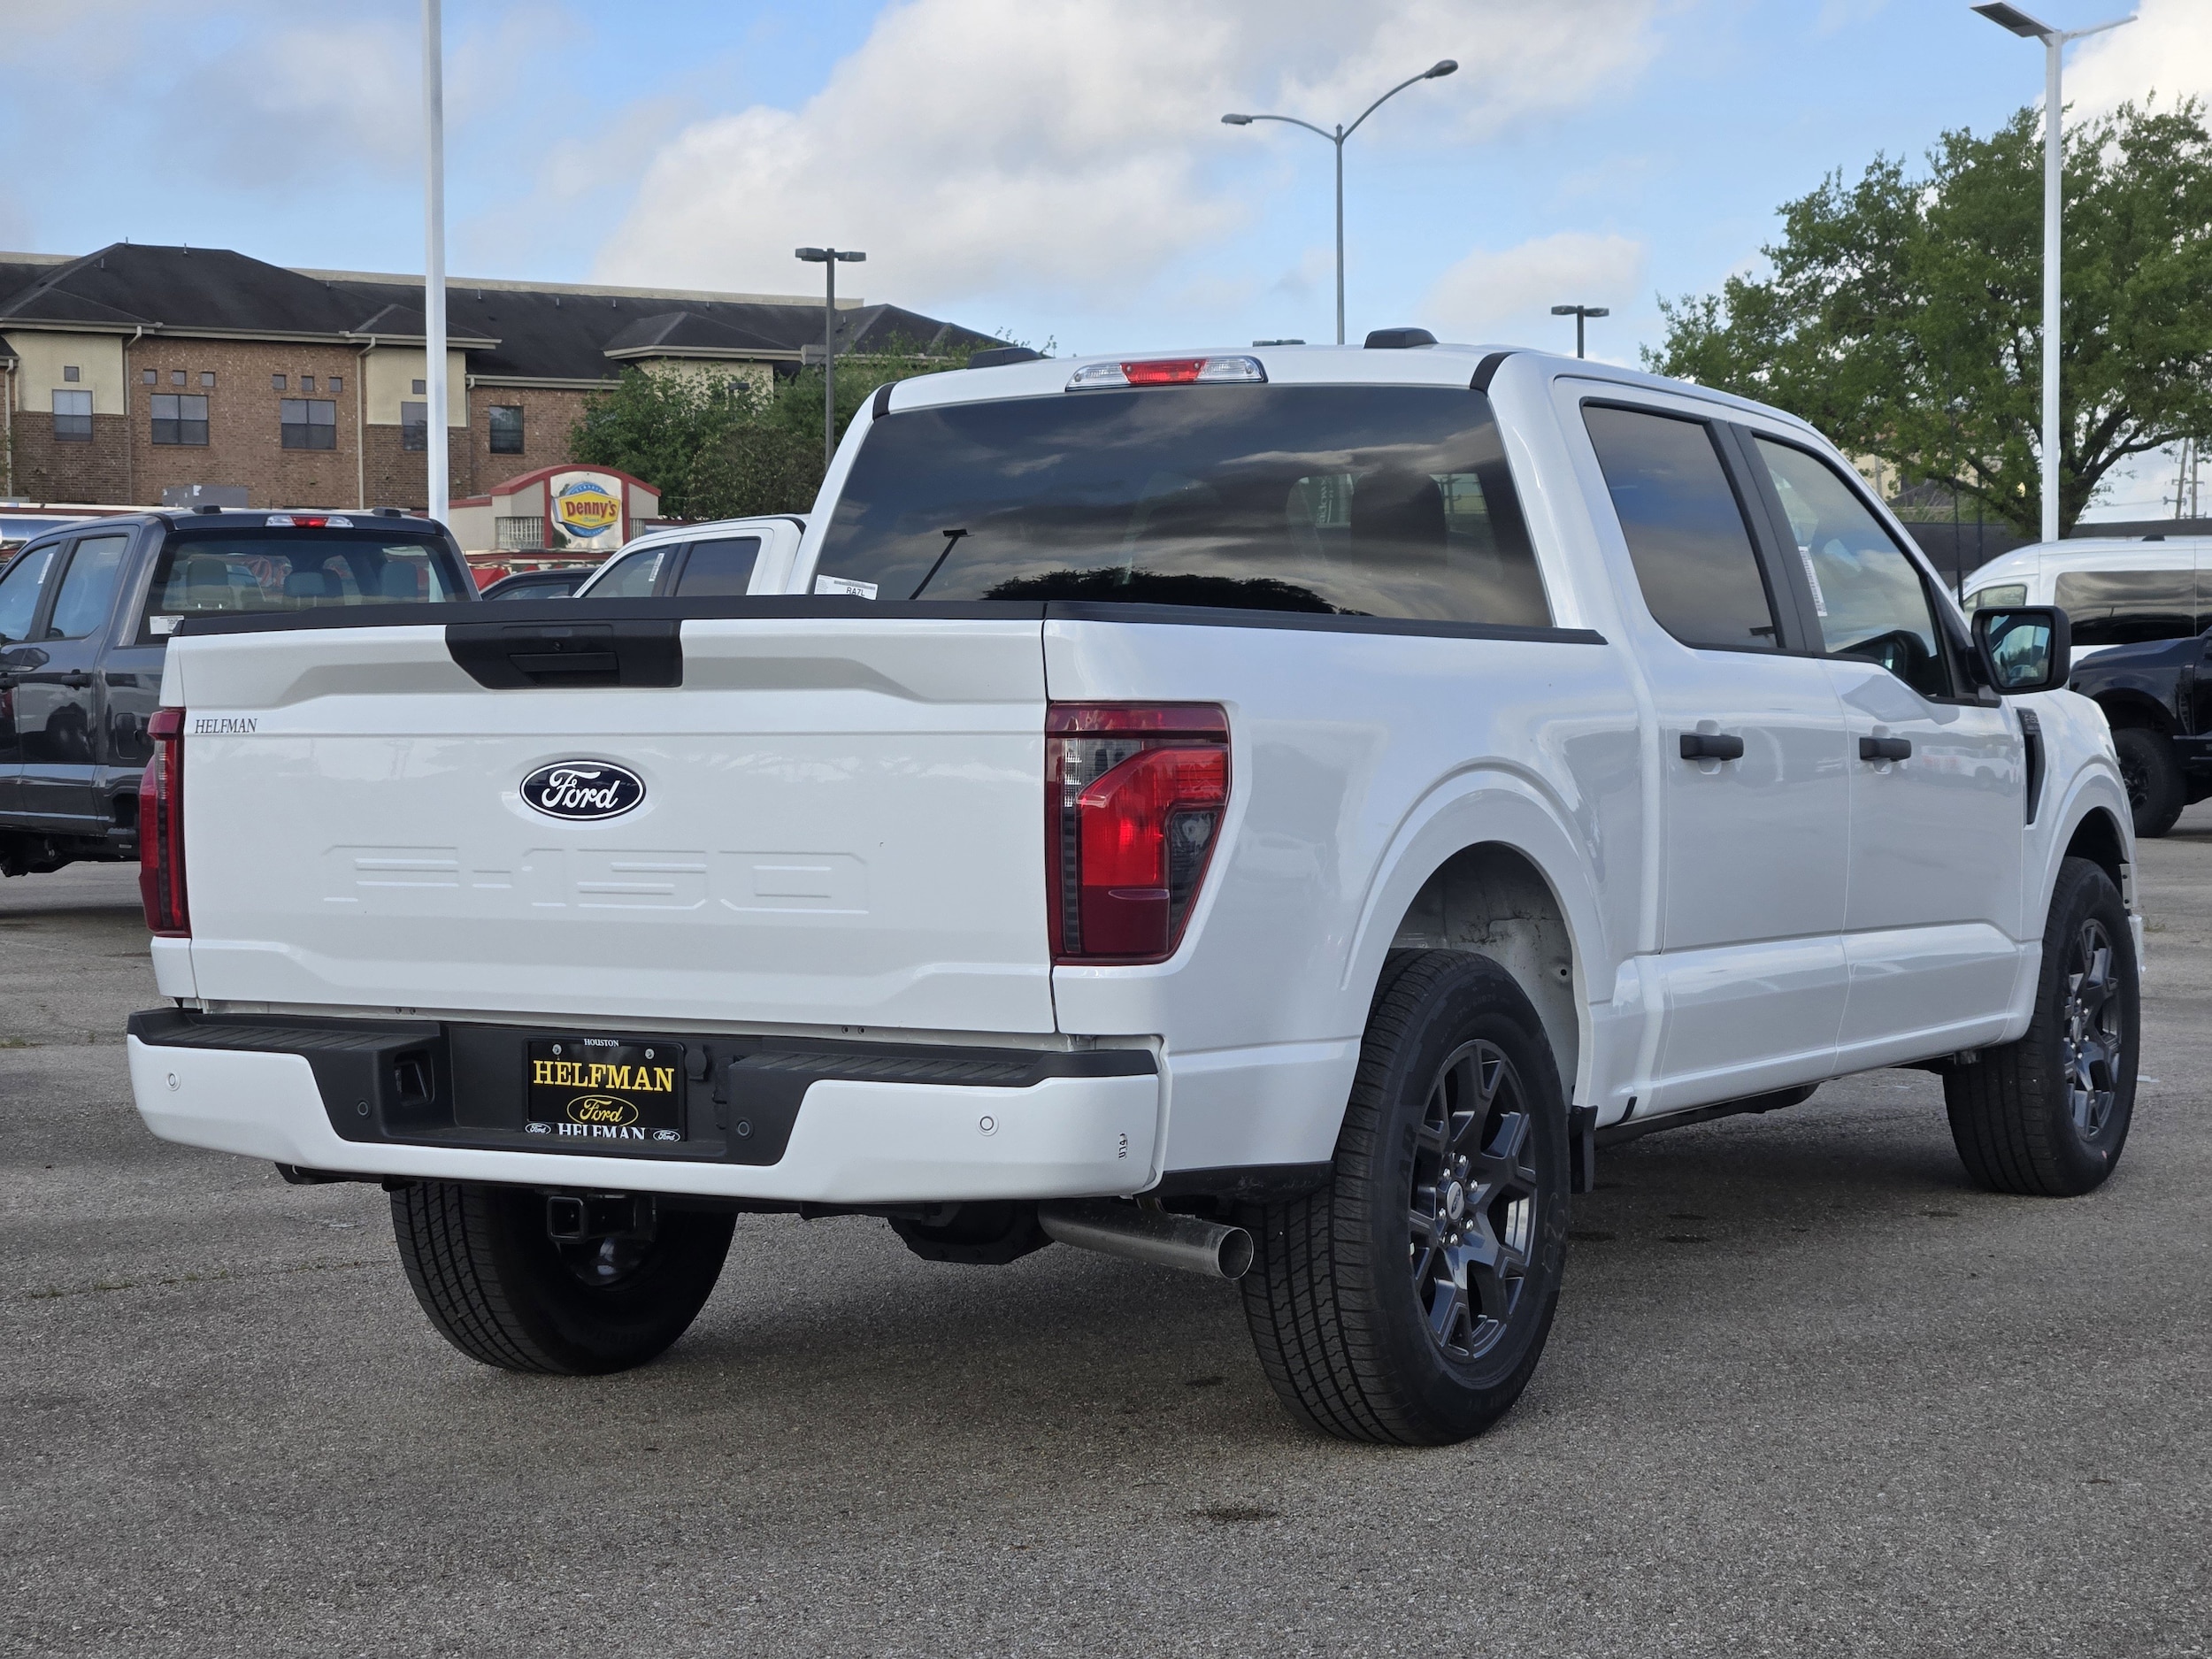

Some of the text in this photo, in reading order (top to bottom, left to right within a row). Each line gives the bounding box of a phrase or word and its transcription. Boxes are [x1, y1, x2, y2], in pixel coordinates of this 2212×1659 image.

[565, 500, 617, 518] Denny's
[195, 718, 258, 733] HELFMAN
[541, 769, 621, 809] Ford
[583, 1038, 619, 1048] HOUSTON
[533, 1060, 674, 1092] HELFMAN
[580, 1098, 624, 1123] Ford
[557, 1122, 646, 1140] HELFMAN
